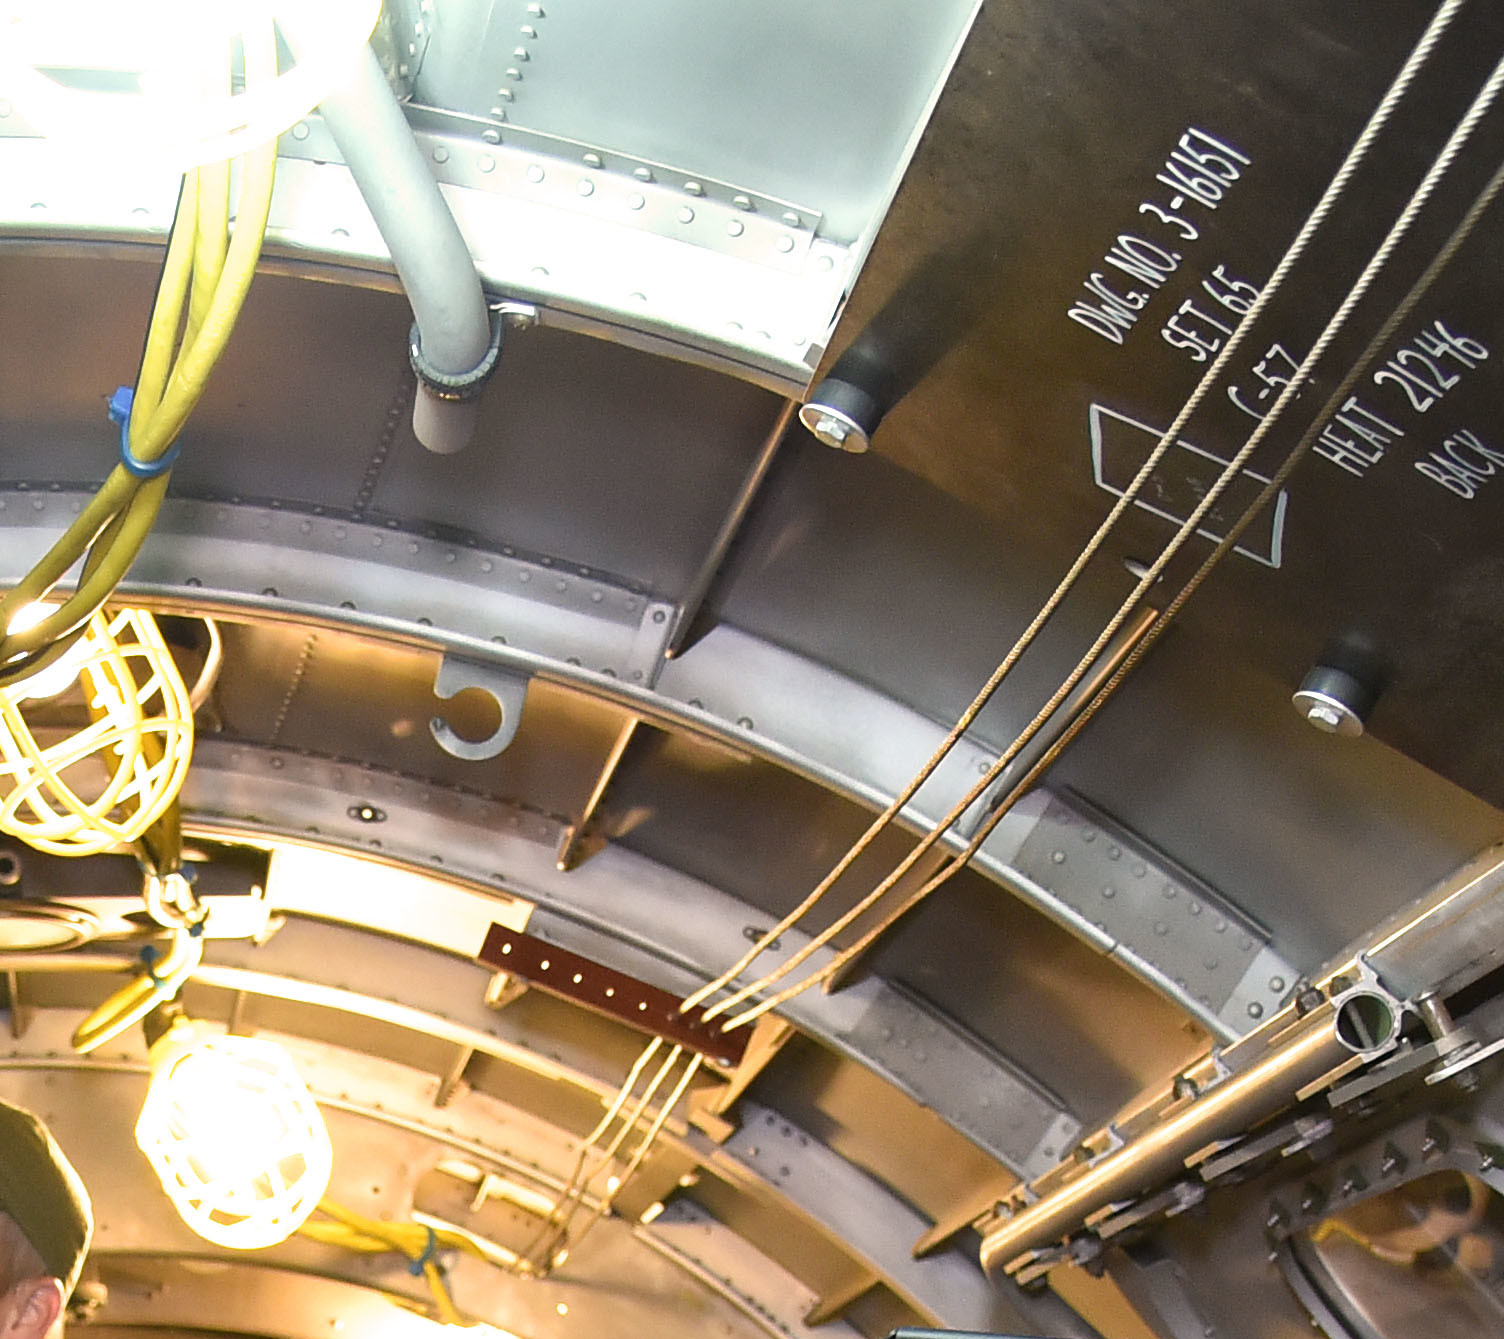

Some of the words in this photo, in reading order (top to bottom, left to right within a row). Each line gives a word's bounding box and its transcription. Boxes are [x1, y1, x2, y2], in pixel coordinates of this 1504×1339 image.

[1138, 127, 1252, 240] 3-16151
[1160, 298, 1233, 363] SET
[1209, 263, 1260, 320] 65
[1312, 396, 1405, 478] HEAT
[1373, 320, 1491, 413] 21246
